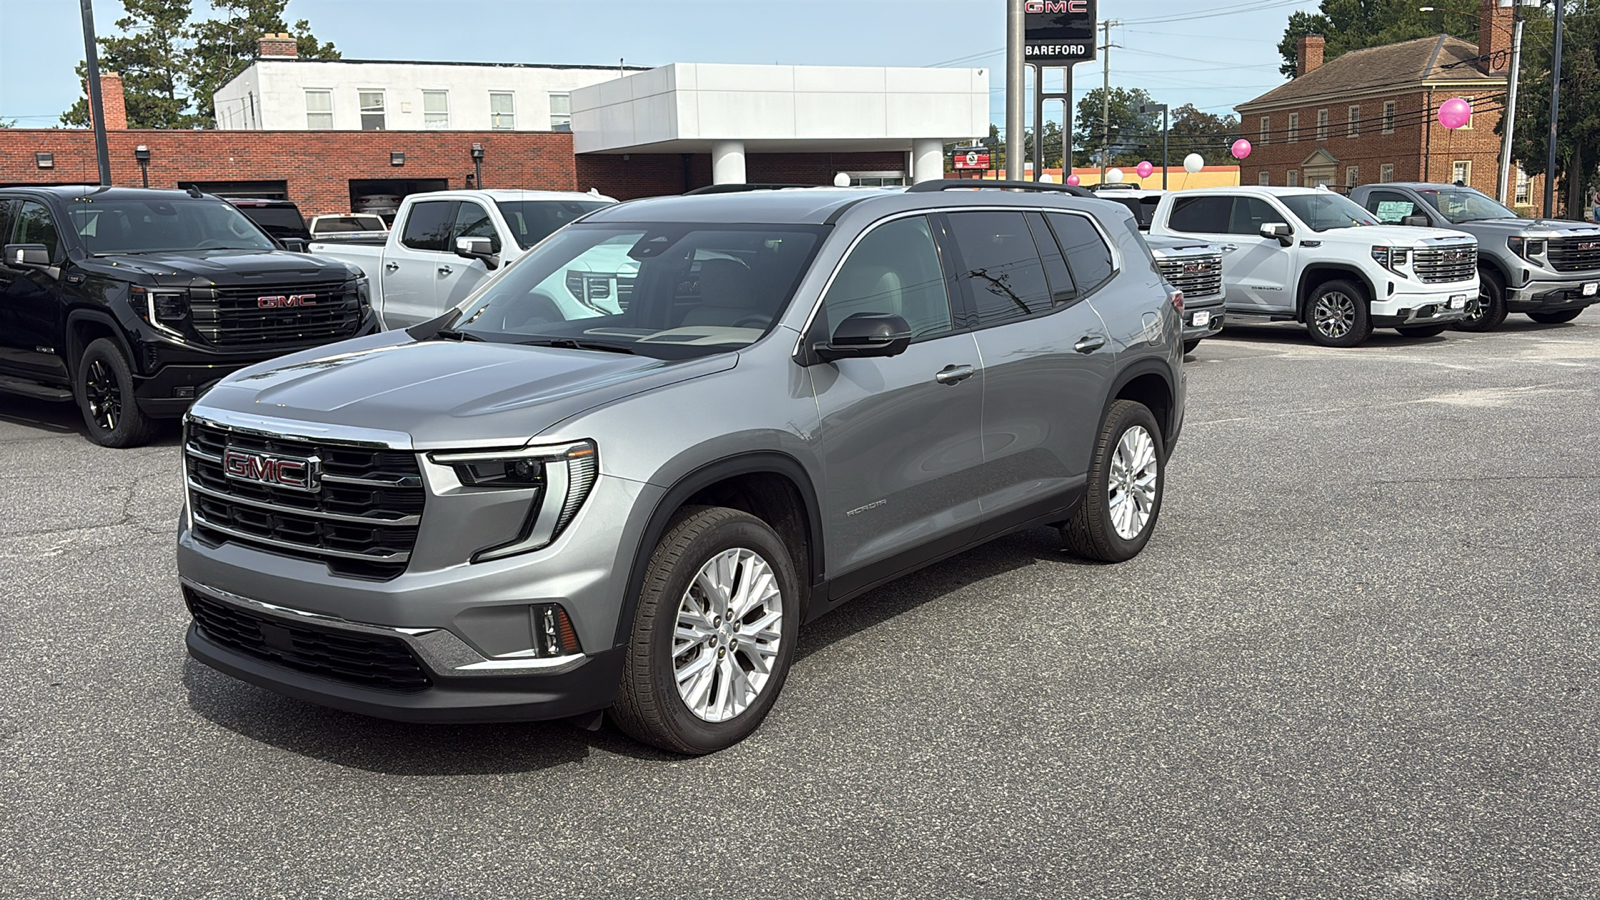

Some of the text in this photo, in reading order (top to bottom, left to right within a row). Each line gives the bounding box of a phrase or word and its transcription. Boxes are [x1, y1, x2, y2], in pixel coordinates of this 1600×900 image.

[1025, 0, 1087, 13] GMC
[1025, 45, 1085, 56] BAREFORD
[257, 294, 317, 309] GMC
[226, 451, 306, 487] GMC
[846, 499, 887, 518] ACADIA
